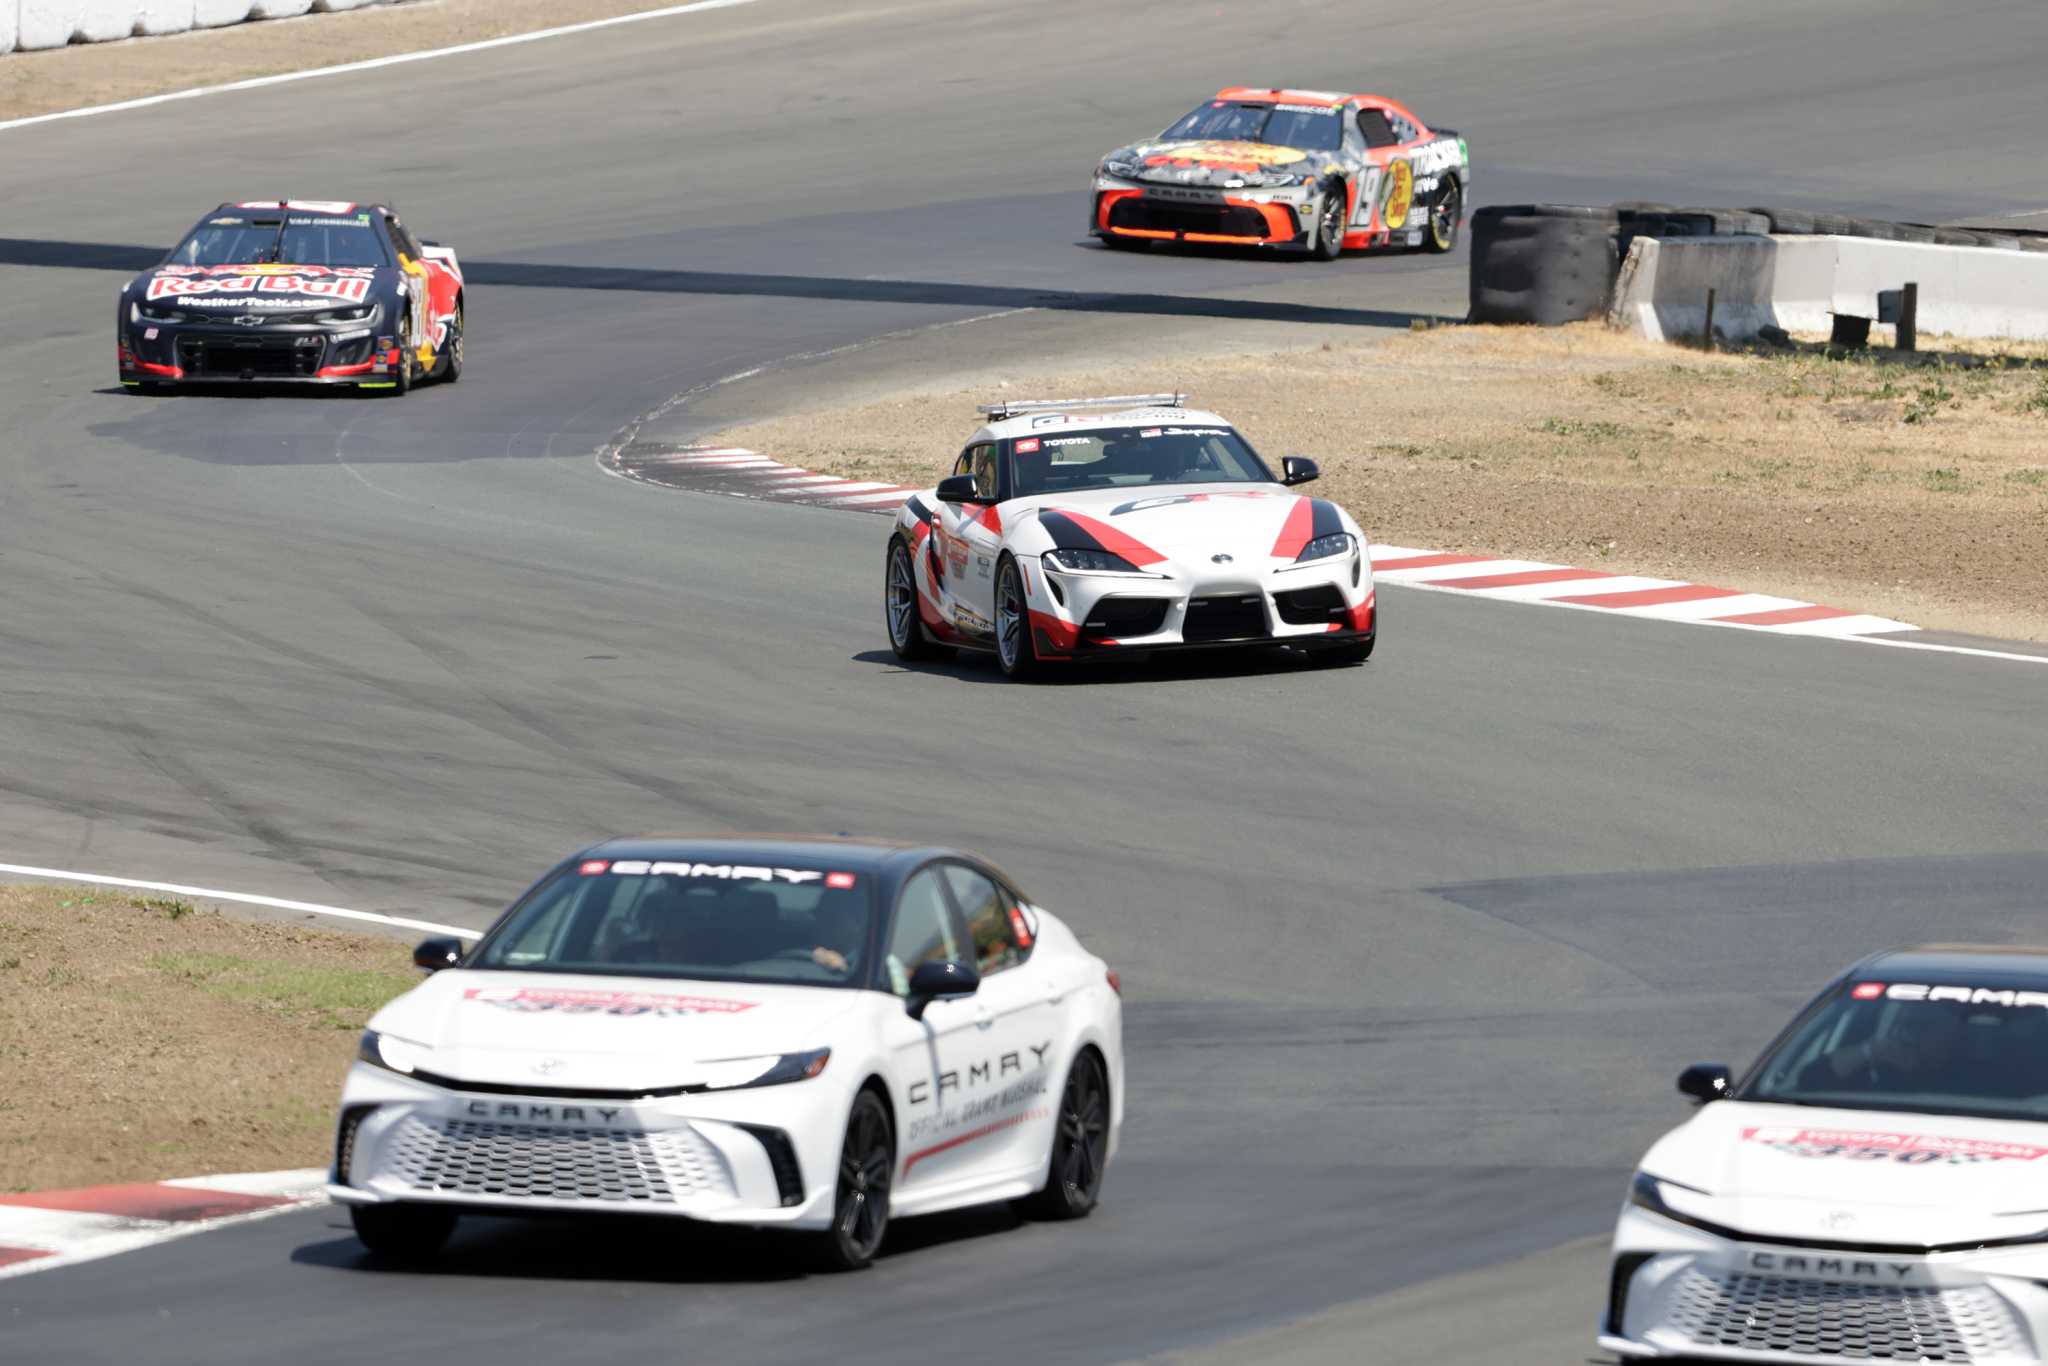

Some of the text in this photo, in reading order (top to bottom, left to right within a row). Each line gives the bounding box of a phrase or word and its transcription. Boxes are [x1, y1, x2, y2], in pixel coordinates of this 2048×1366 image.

[150, 277, 370, 303] Red Bull
[1043, 436, 1091, 448] TOYOTA
[611, 860, 823, 883] CAMRY
[909, 1038, 1051, 1105] CAMRY
[469, 1101, 619, 1122] CAMRY
[1752, 1252, 1913, 1277] CAMRY
